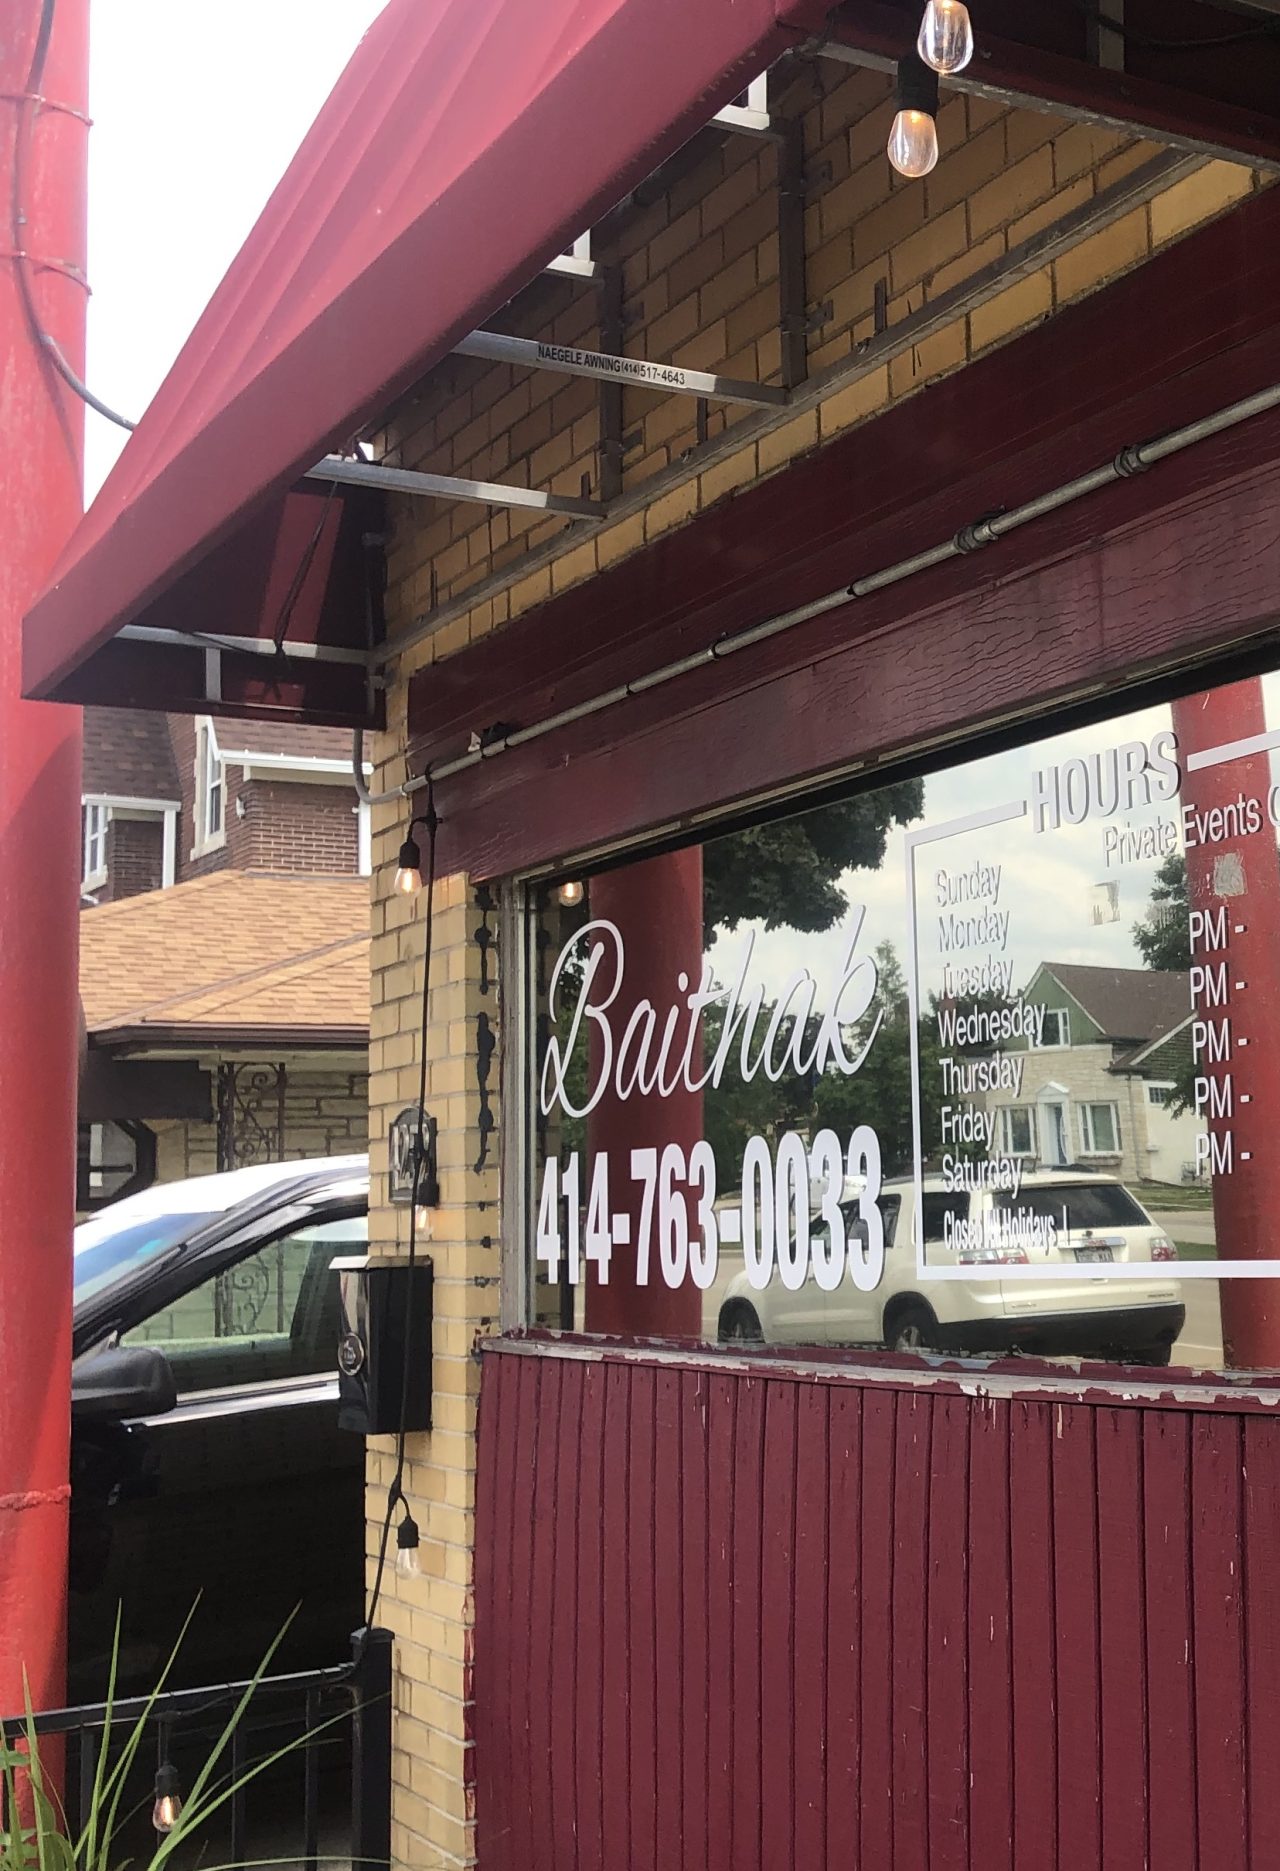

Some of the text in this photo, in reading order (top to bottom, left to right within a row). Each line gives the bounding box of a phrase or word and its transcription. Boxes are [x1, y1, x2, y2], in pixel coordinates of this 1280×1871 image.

[538, 346, 582, 365] NAEGELE
[583, 354, 621, 373] AWNING
[1031, 731, 1181, 833] HOURS
[1101, 815, 1177, 867] Private
[1182, 793, 1261, 849] Events
[936, 860, 1002, 908] Sunday
[938, 905, 1010, 953] Monday
[1189, 906, 1228, 955] PM
[939, 954, 1014, 1001] Tuesday
[1190, 961, 1228, 1010] PM
[541, 905, 884, 1118] Baithak
[938, 997, 1046, 1049] Wednesday
[1192, 1018, 1231, 1066] PM
[939, 1050, 1024, 1099] Thursday
[1194, 1074, 1233, 1121] PM
[941, 1103, 996, 1151] Friday
[942, 1150, 1022, 1199] Saturday
[1195, 1130, 1233, 1177] PM
[536, 1125, 885, 1291] 414-763-0033
